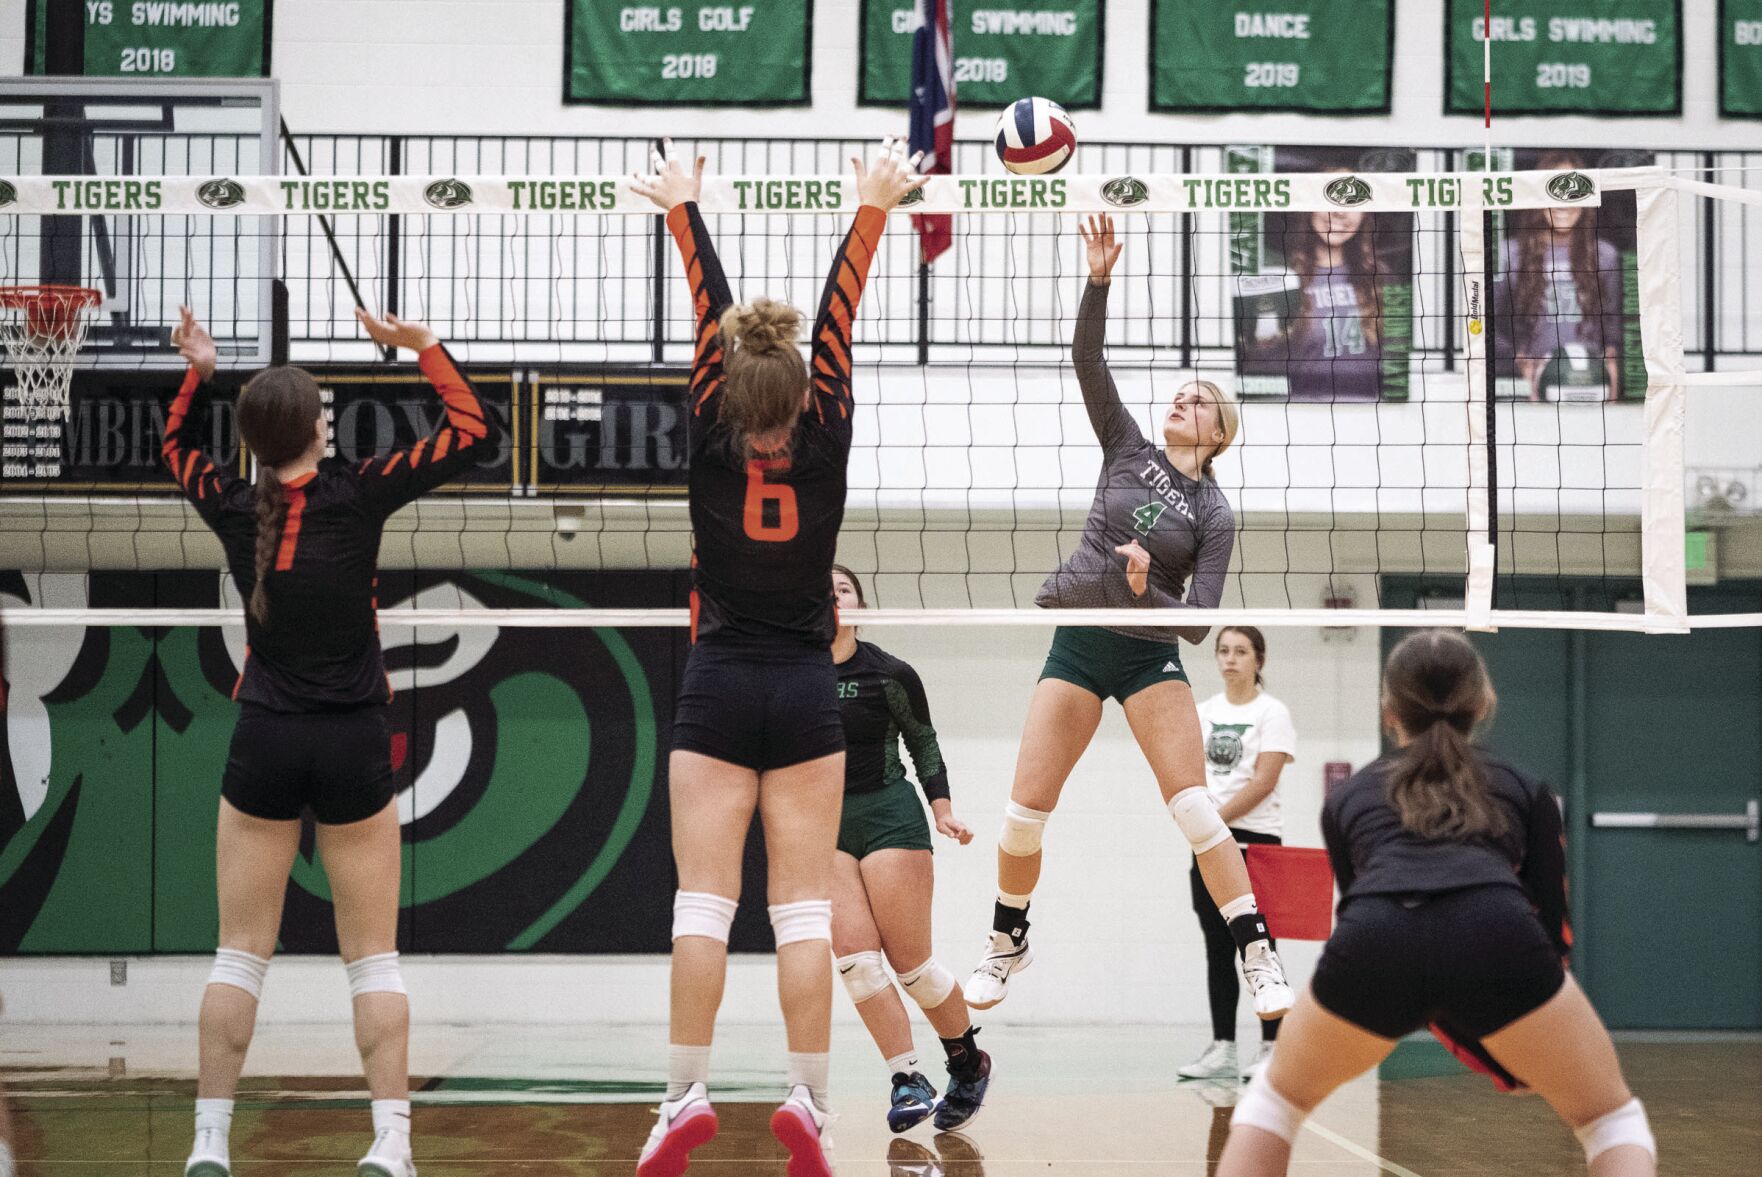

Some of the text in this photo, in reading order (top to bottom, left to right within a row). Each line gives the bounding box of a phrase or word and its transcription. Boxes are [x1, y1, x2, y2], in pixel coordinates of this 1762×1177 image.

[131, 2, 240, 26] SWIMMING
[620, 7, 754, 31] GIRLS GOLF
[971, 10, 1077, 35] SWIMMING
[1234, 13, 1311, 39] DANCE
[1472, 17, 1657, 43] GIRLS SWIMMING
[120, 48, 175, 72] 2018
[661, 54, 717, 79] 2018
[954, 58, 1008, 82] 2018
[1244, 62, 1300, 87] 2019
[1536, 63, 1591, 88] 2019
[53, 181, 161, 209] TIGERS
[281, 181, 389, 209] TIGERS
[508, 181, 615, 209] TIGERS
[734, 181, 841, 209] TIGERS
[959, 180, 1066, 207] TIGERS
[1183, 179, 1290, 207] TIGERS
[1406, 177, 1512, 206] TIGRS
[540, 399, 690, 469] GIR
[743, 459, 799, 542] 6
[1140, 460, 1194, 520] TIGER
[1132, 501, 1168, 536] 4
